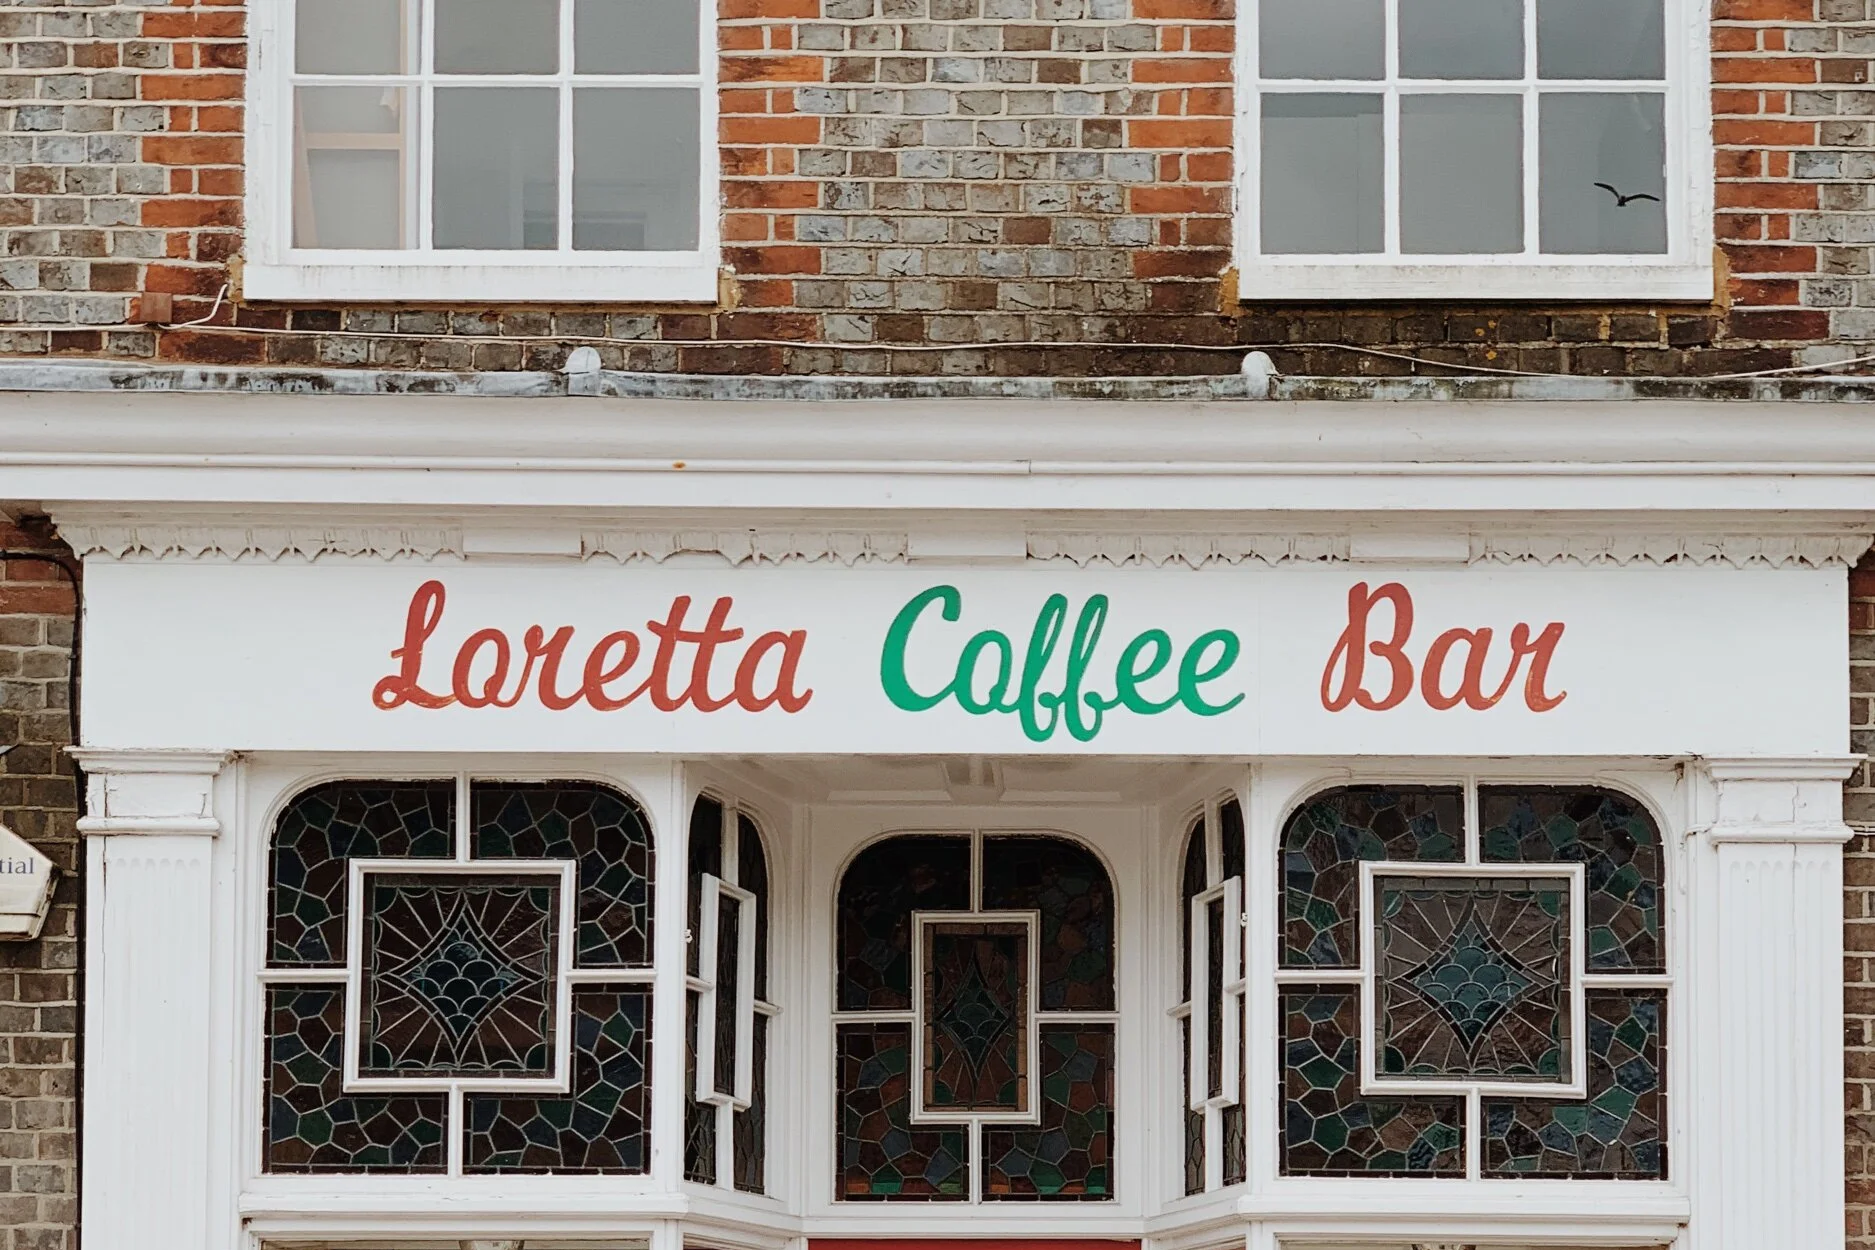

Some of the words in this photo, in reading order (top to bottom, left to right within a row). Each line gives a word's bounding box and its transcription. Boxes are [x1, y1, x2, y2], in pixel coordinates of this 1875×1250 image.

[373, 579, 812, 711] Loretta
[881, 582, 1245, 742] Coffee
[1321, 582, 1567, 712] Bar
